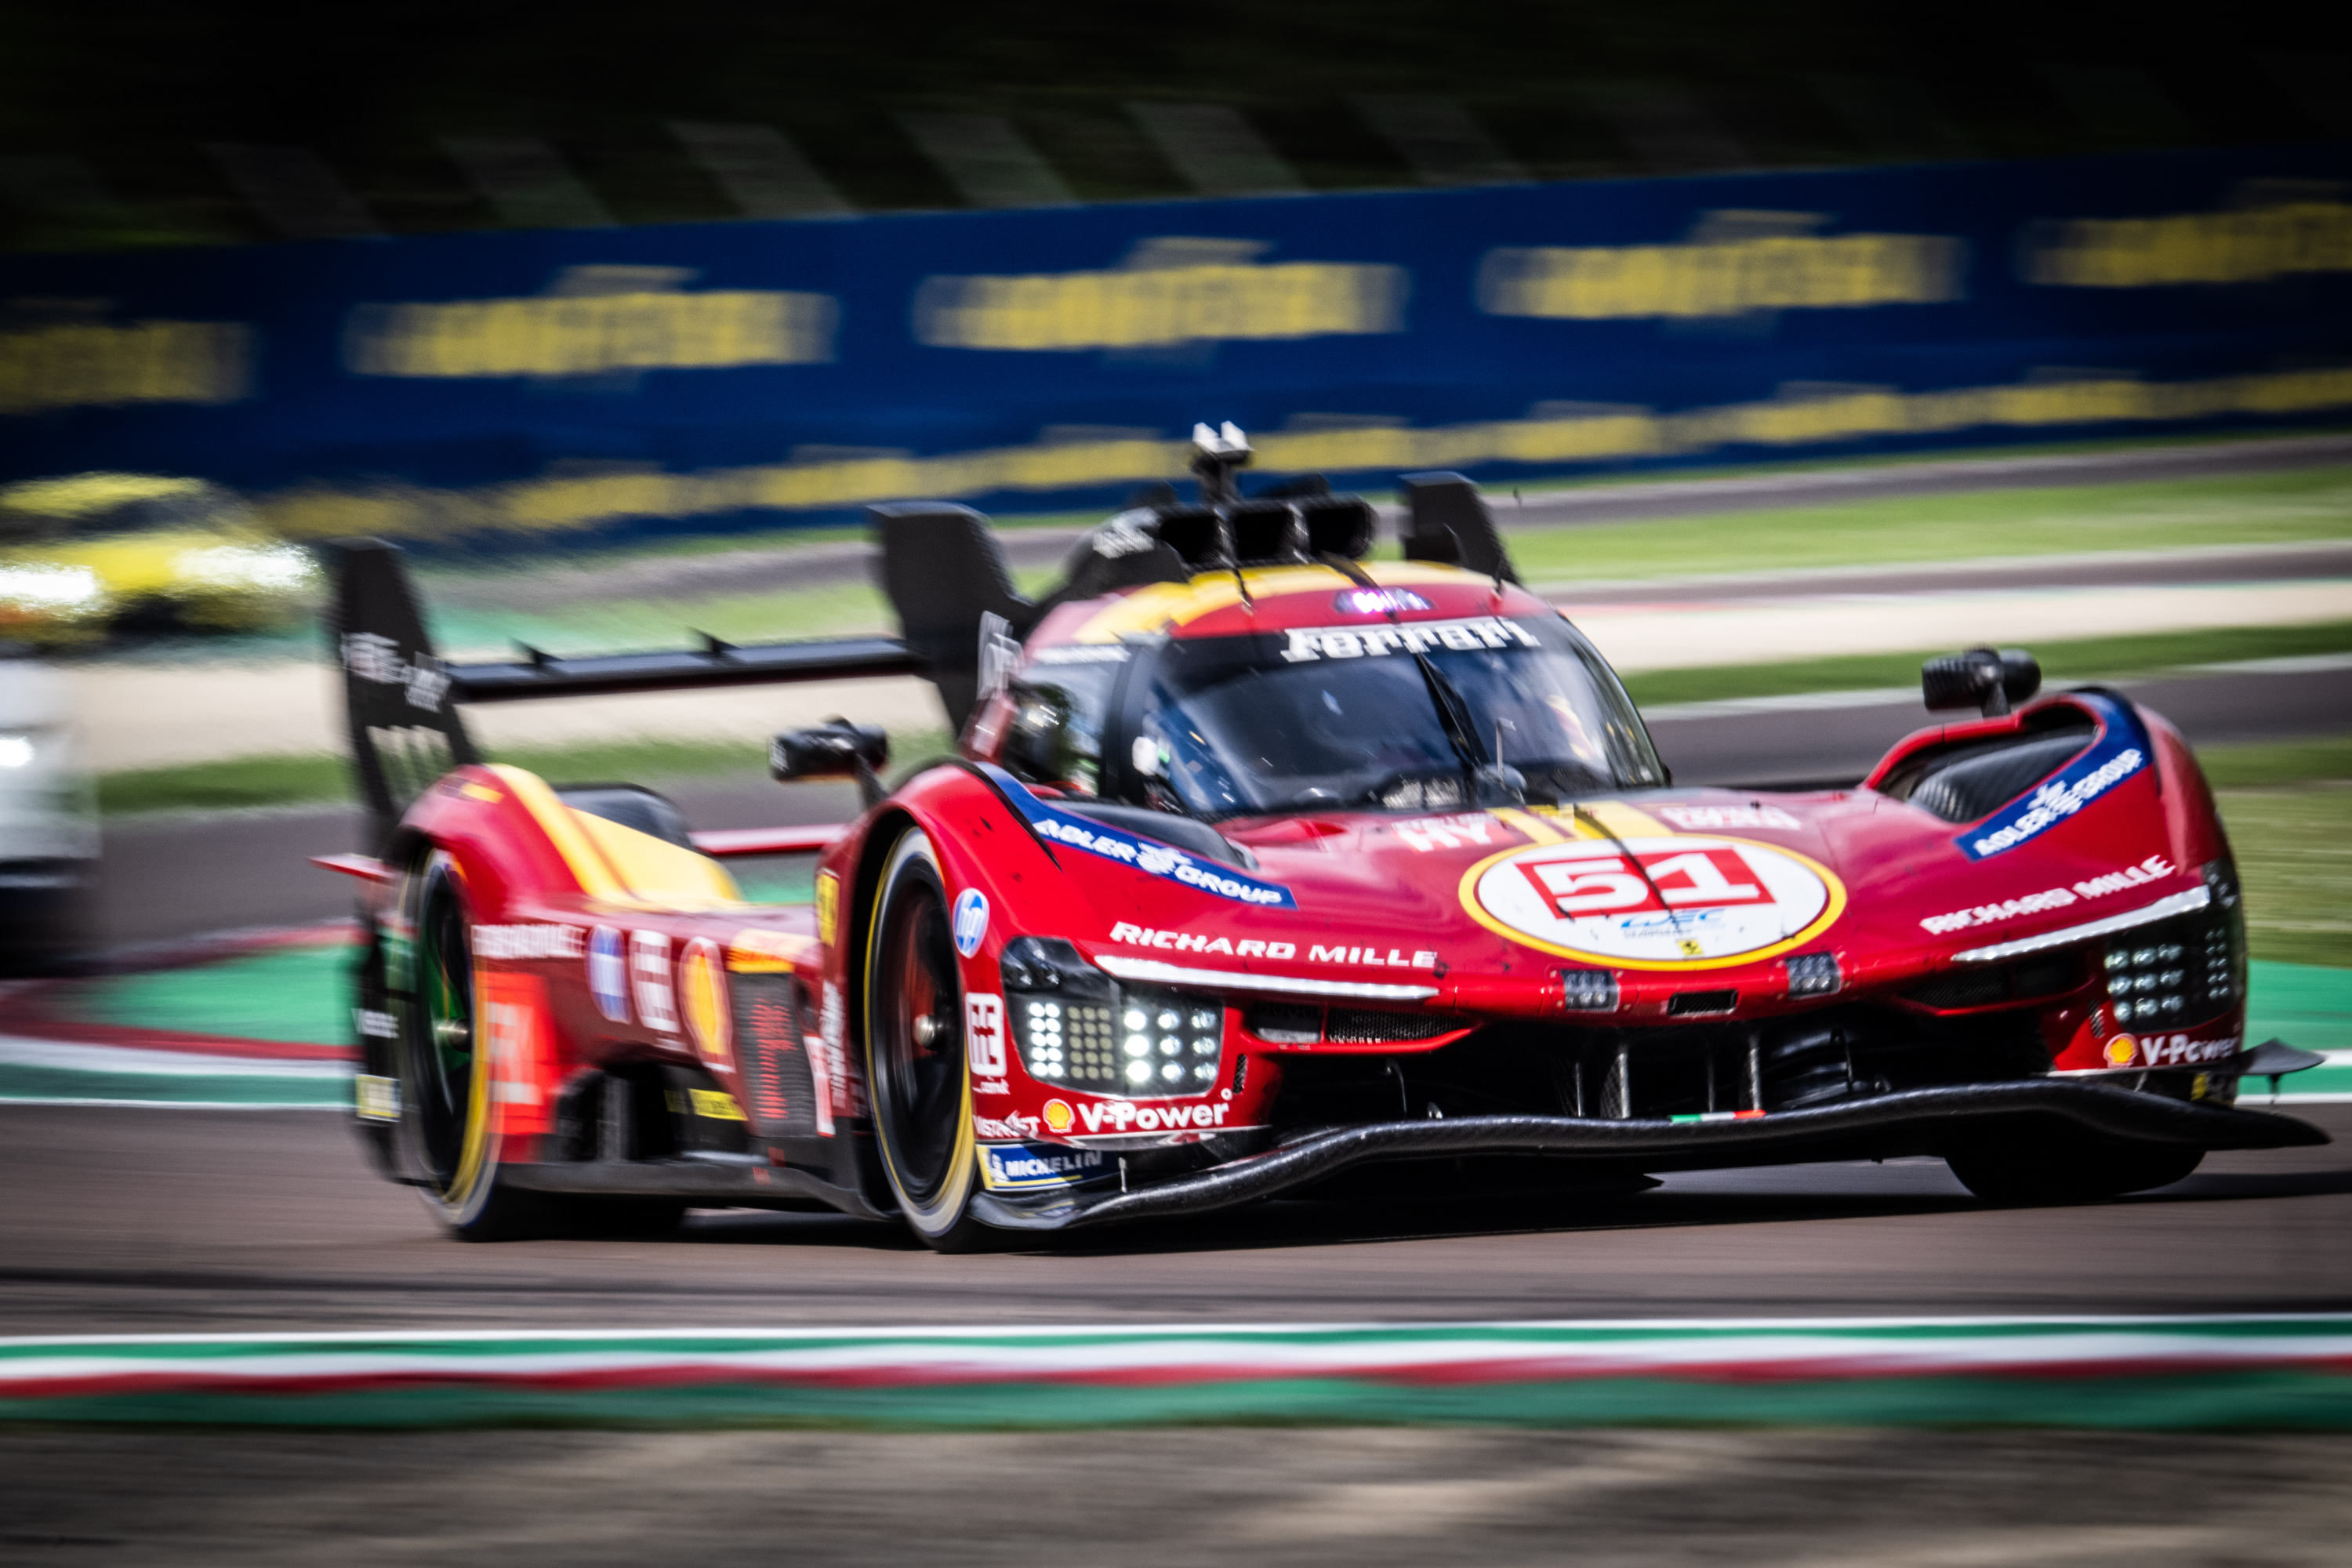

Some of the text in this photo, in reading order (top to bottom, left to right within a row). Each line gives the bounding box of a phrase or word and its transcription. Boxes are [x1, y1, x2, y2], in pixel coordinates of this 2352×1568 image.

[1280, 616, 1541, 662] Ferrari
[1032, 818, 1283, 905] ADLER GROUP
[1534, 851, 1761, 911] 51
[1919, 854, 2176, 935] RICHARD MILLE
[1109, 920, 1438, 968] RICHARD MILLE
[1076, 1101, 1229, 1133] V-Power
[1004, 1150, 1102, 1177] MICHELIN
